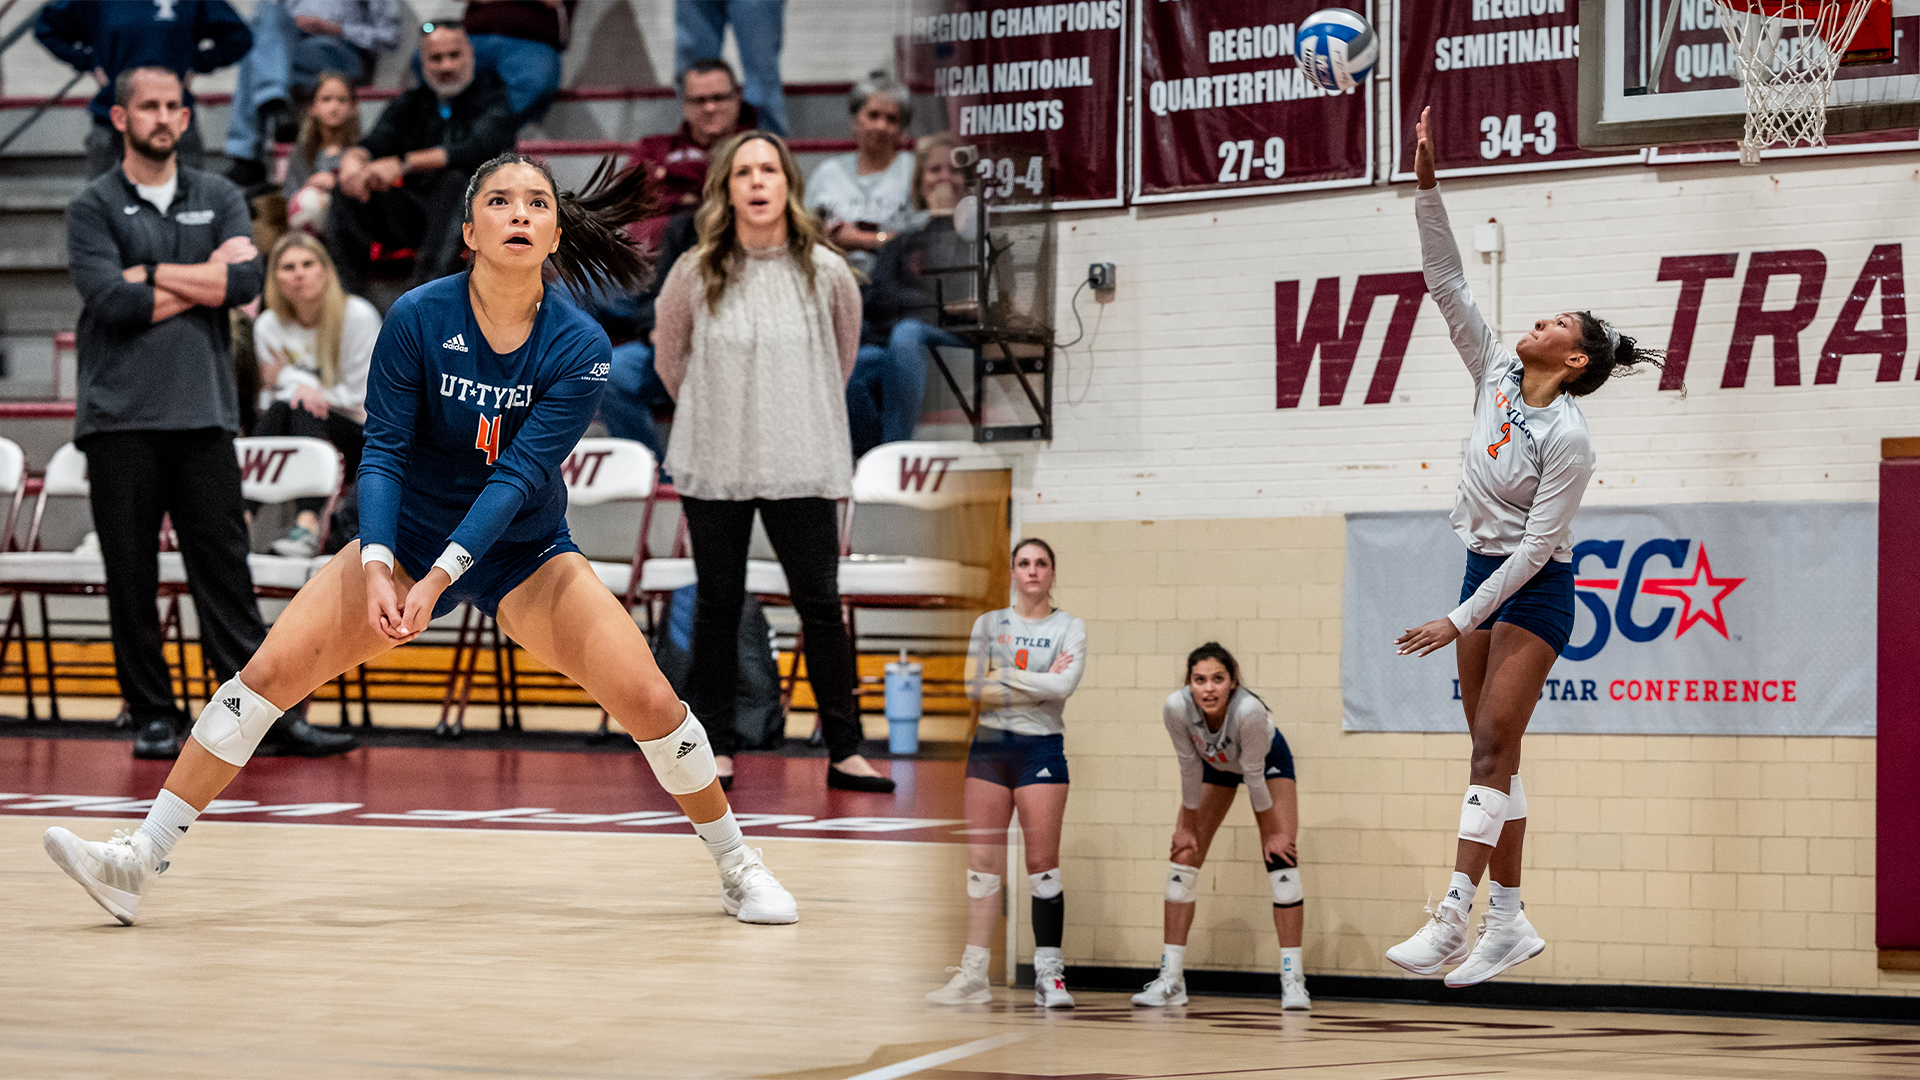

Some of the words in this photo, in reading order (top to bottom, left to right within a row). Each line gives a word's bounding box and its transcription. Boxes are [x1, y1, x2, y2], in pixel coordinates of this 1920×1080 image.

[913, 11, 988, 45] REGION
[990, 1, 1122, 39] CHAMPIONS
[1208, 23, 1296, 63] REGION
[934, 64, 990, 97] NCAA
[993, 56, 1093, 93] NATIONAL
[1150, 67, 1355, 116] QUARTERFINAL
[960, 99, 1064, 136] FINALISTS
[1480, 111, 1557, 160] 34-3
[1218, 136, 1286, 183] 27-9
[1656, 243, 1920, 391] TRA
[442, 342, 469, 353] adidas
[1275, 270, 1430, 409] WT
[475, 412, 503, 466] 4
[1487, 422, 1512, 460] 2
[241, 448, 298, 483] WT
[900, 456, 959, 492] WT
[1539, 679, 1598, 701] TAR
[1609, 679, 1797, 702] CONFERENCE
